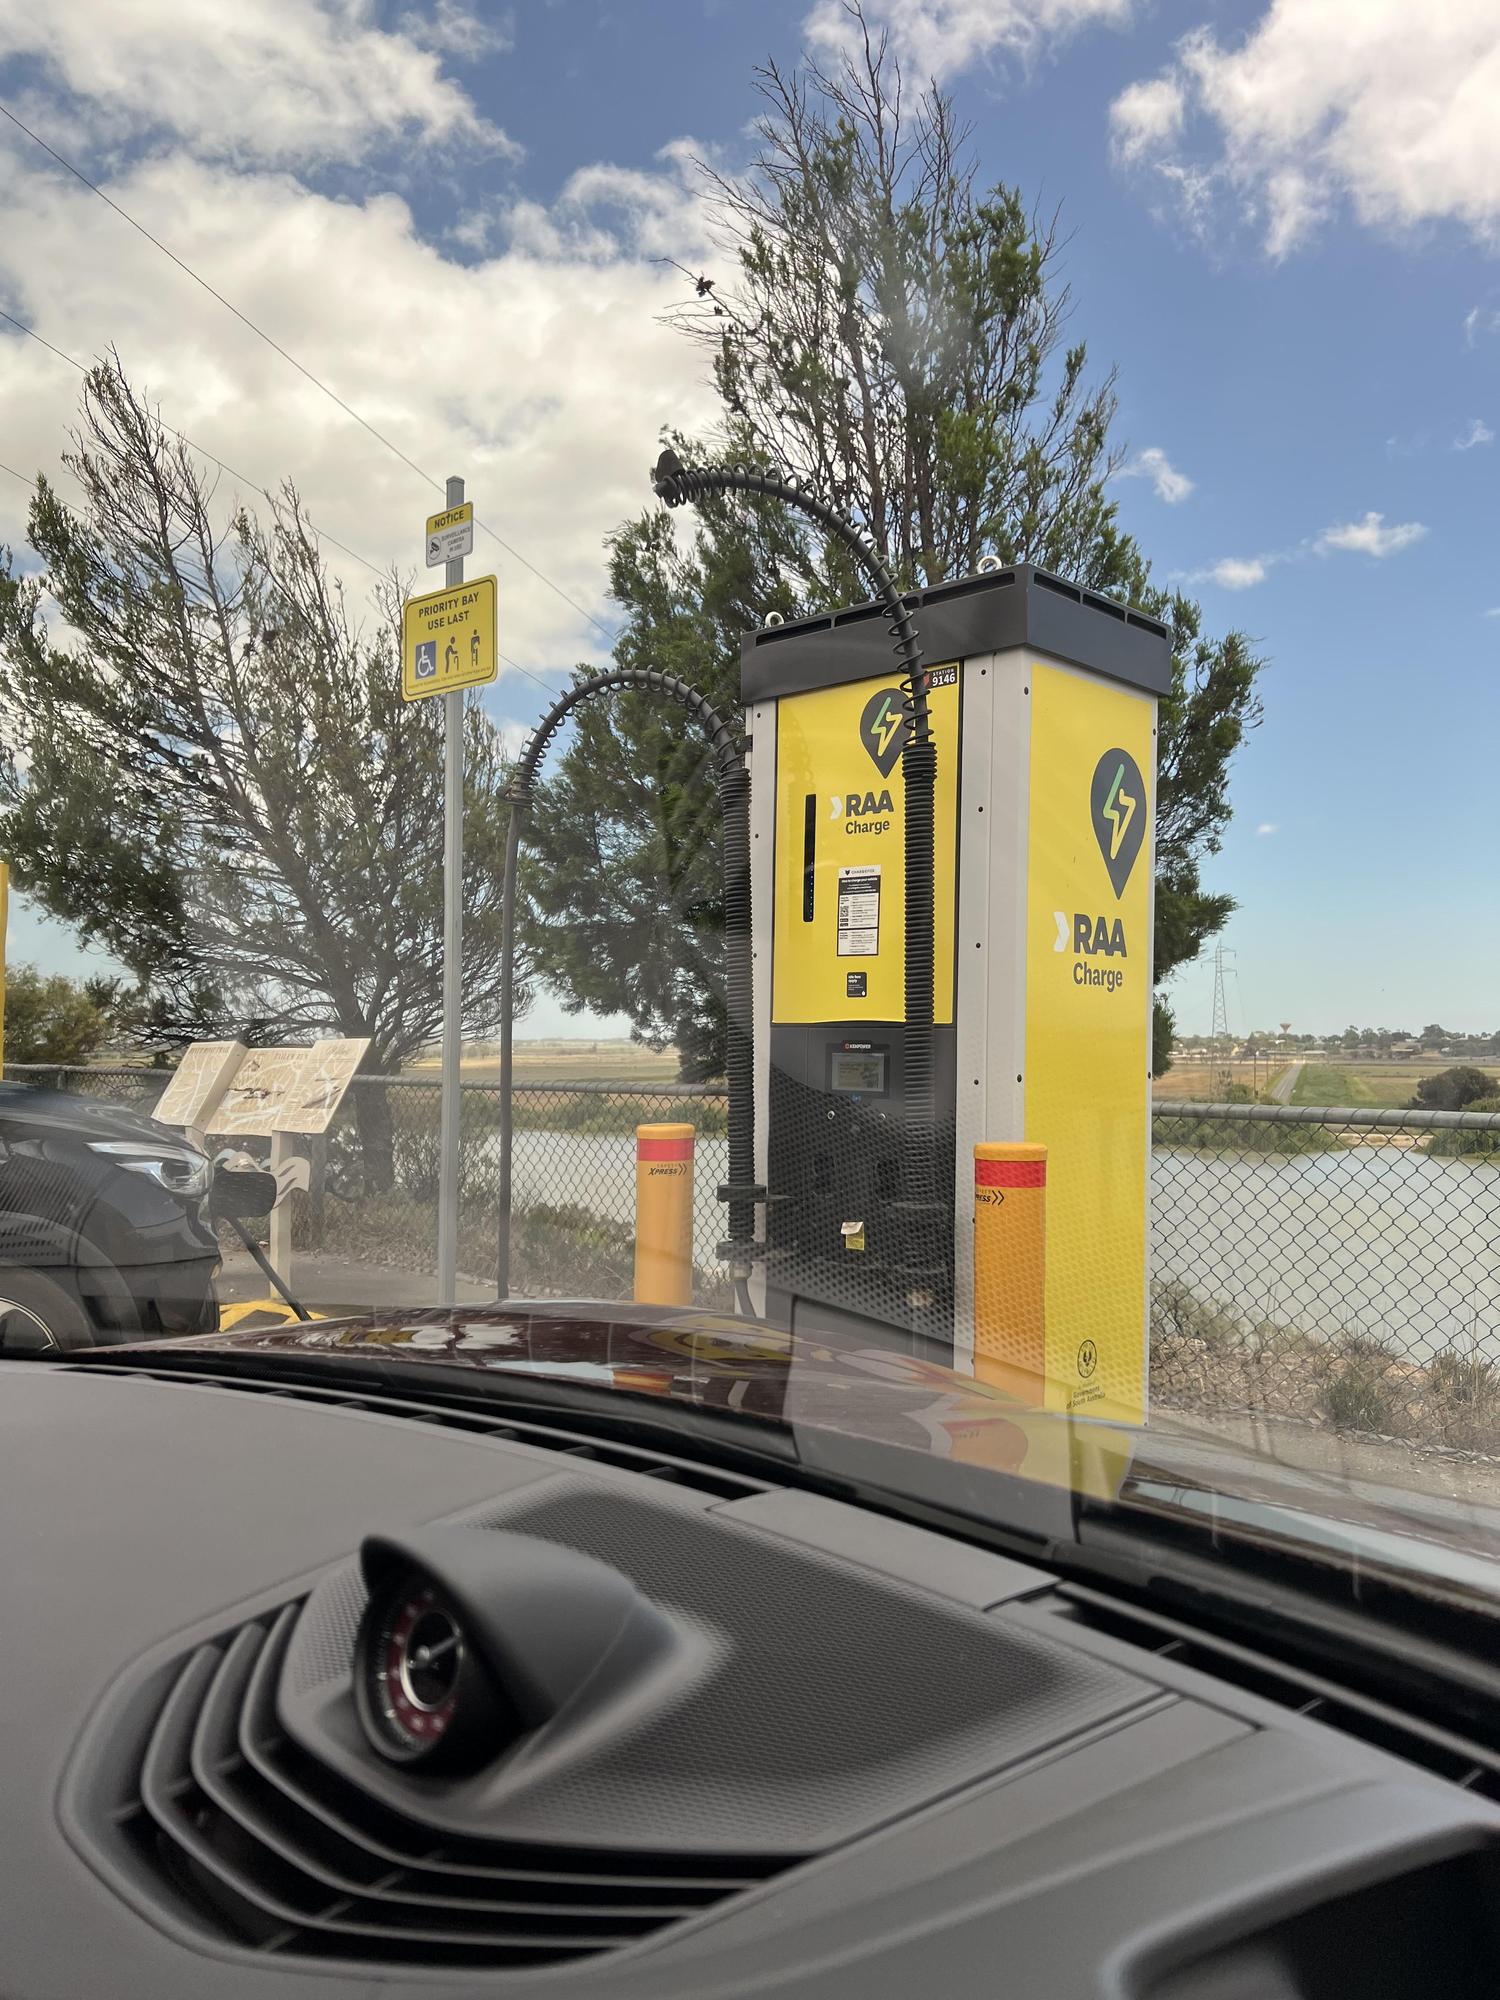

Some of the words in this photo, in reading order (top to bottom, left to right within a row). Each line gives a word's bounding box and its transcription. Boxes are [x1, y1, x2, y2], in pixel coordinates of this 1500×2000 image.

[434, 510, 464, 529] NOTICE
[418, 597, 459, 618] PRIORITY
[462, 591, 480, 606] BAY
[427, 617, 444, 631] USE
[447, 610, 470, 625] LAST
[932, 668, 955, 677] STATION
[932, 672, 955, 686] 9146
[845, 789, 894, 817] RAA
[845, 820, 890, 835] Charge
[1073, 913, 1127, 958] RAA
[1073, 961, 1123, 993] Charge
[647, 1167, 678, 1176] XPRESS
